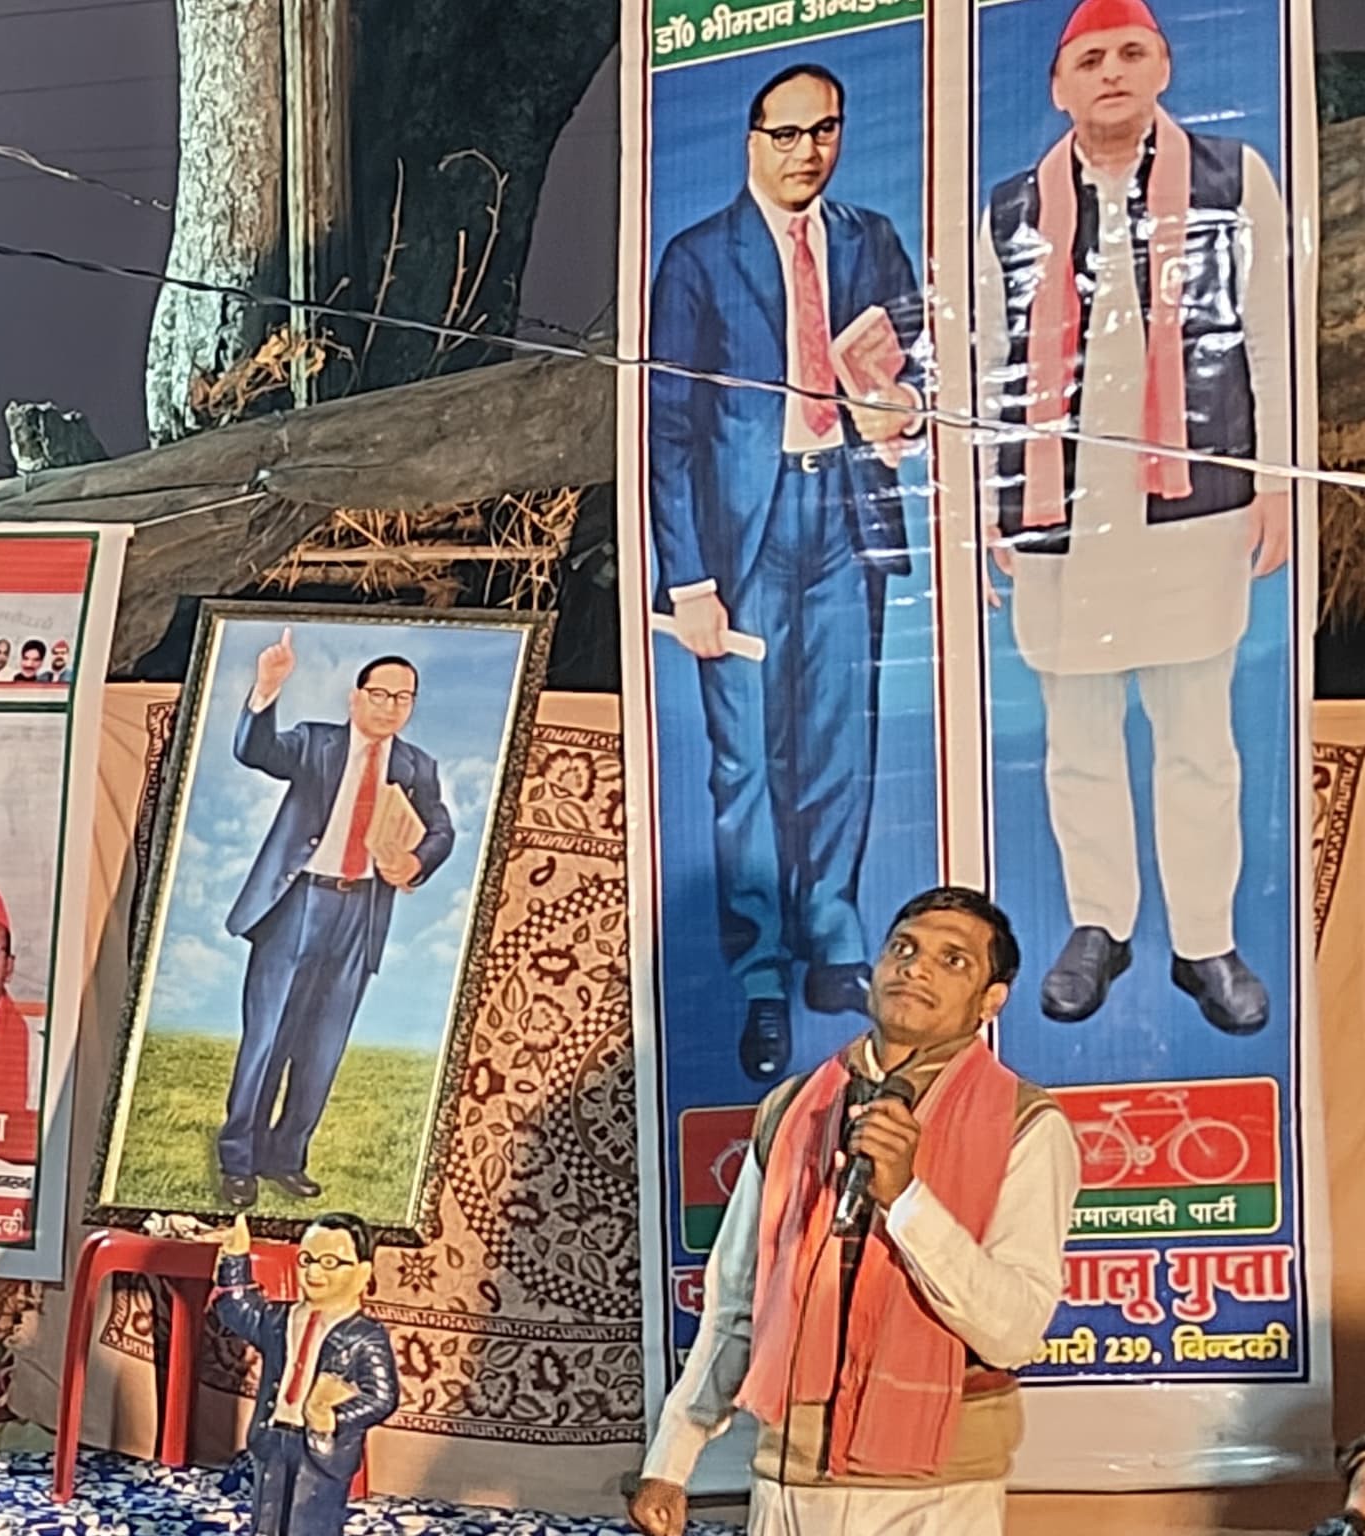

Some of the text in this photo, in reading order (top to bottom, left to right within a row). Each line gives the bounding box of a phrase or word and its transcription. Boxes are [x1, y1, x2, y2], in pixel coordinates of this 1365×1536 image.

[700, 0, 796, 42] भीमराव
[1188, 1195, 1238, 1225] पार्टी
[1166, 1246, 1294, 1323] गुप्ता
[1103, 1337, 1163, 1365] 239,
